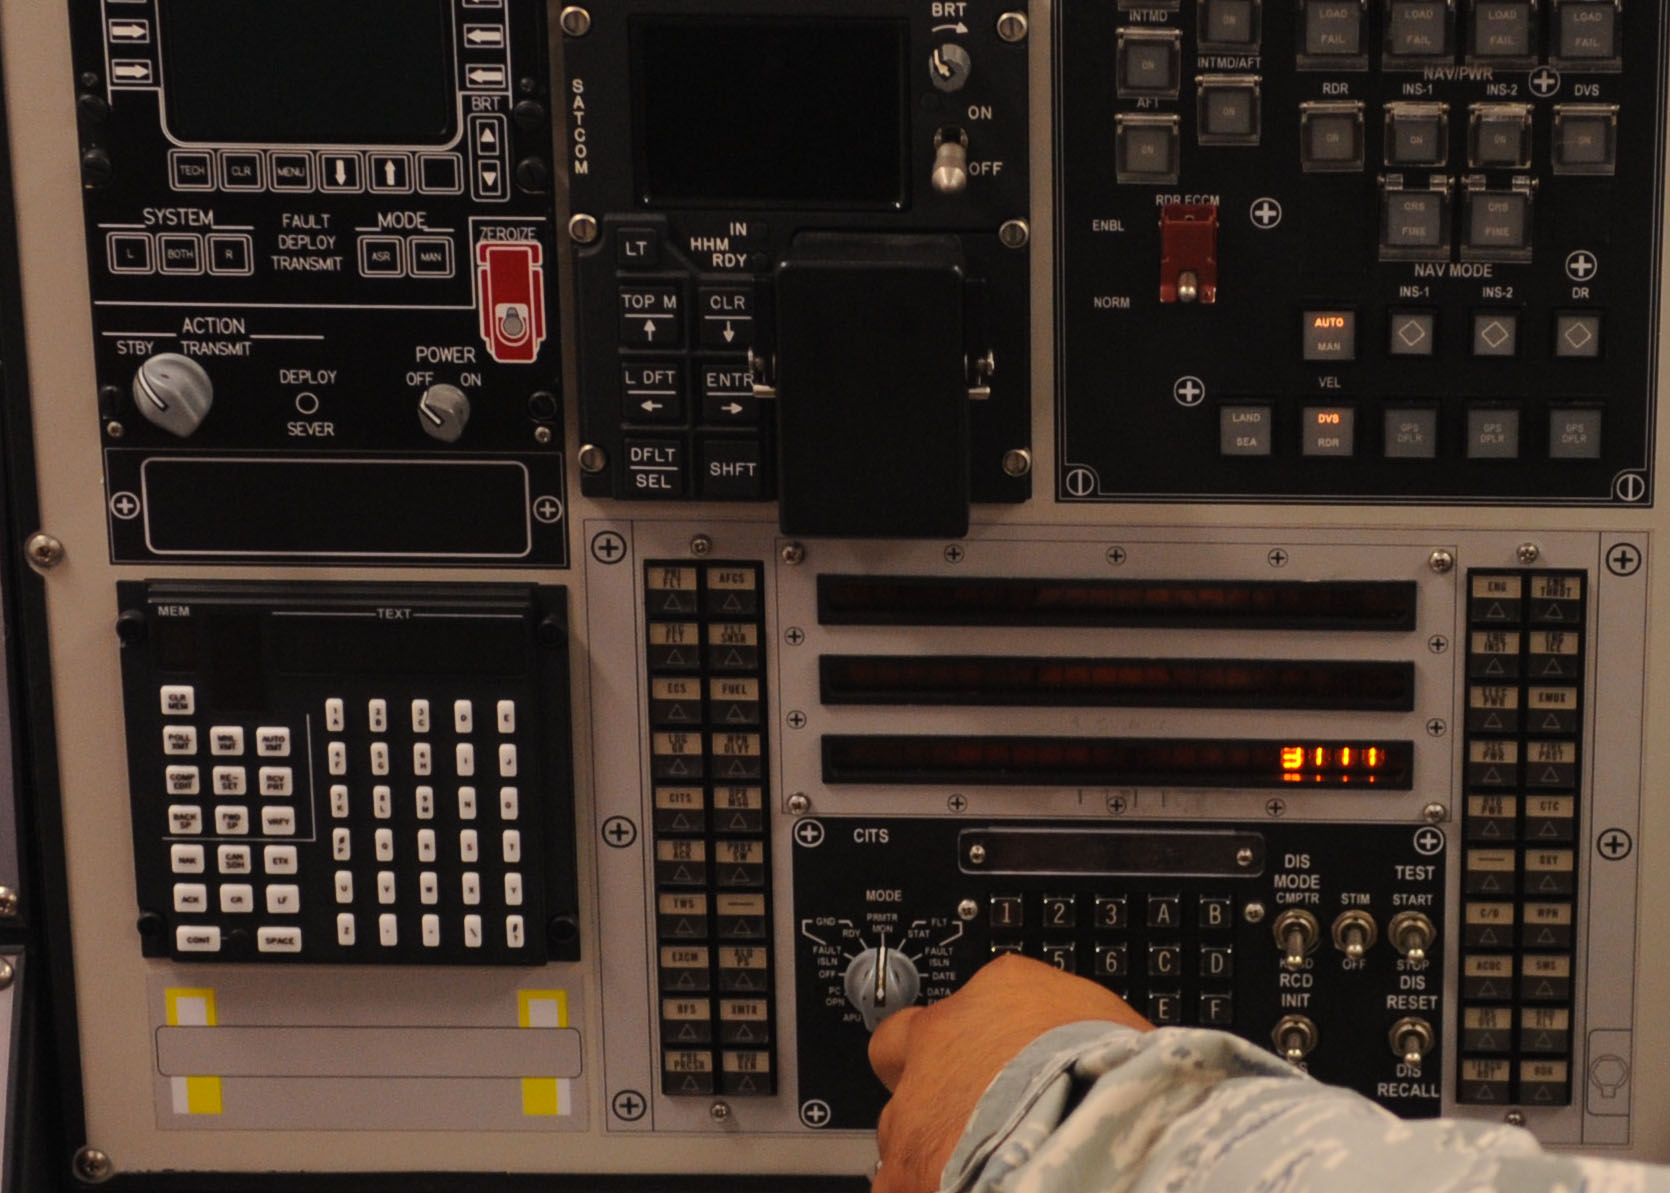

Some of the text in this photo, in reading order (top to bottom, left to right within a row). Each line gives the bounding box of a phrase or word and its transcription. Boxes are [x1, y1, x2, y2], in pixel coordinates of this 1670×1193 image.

[932, 3, 966, 17] BRT
[1129, 10, 1167, 23] INTMD
[1198, 57, 1262, 69] INTMD/AFT
[1424, 66, 1493, 82] NAV/PWR
[1323, 83, 1349, 95] RDR
[1403, 83, 1432, 96] INS-1
[1487, 84, 1518, 96] INS-2
[1575, 84, 1599, 97] DVS
[472, 97, 500, 111] BRT
[1137, 97, 1159, 109] AFT
[968, 107, 992, 120] ON
[572, 79, 588, 174] SATCOM
[180, 166, 205, 176] TECH
[231, 166, 251, 176] CLR
[277, 166, 304, 177] MENU
[969, 162, 1002, 176] OFF
[1156, 195, 1182, 207] RDR
[144, 209, 213, 226] SYSTEM
[283, 214, 330, 229] FAULT
[378, 212, 426, 229] MODE
[730, 223, 747, 237] IN
[1093, 220, 1124, 232] ENBL
[480, 227, 536, 242] ZEROIZE
[279, 235, 335, 250] DEPLOY
[625, 241, 647, 255] LT
[690, 238, 729, 251] HHM
[168, 249, 194, 260] BOTH
[421, 252, 441, 262] MAN
[712, 254, 747, 267] RDY
[272, 256, 341, 272] TRANSMIT
[1415, 264, 1493, 277] NAV MODE
[1400, 286, 1430, 297] INS-1
[1483, 287, 1513, 298] INS-2
[1572, 287, 1589, 299] DR
[623, 295, 677, 309] TOP M
[710, 296, 745, 310] CLR
[1094, 297, 1130, 308] NORM
[182, 318, 245, 334] ACTION
[1314, 317, 1344, 328] AUTO
[117, 341, 153, 355] STBY
[182, 341, 251, 356] TRANSMIT
[416, 347, 476, 363] POWER
[280, 370, 337, 385] DEPLOY
[406, 372, 433, 387] OFF
[460, 373, 481, 387] ON
[625, 371, 675, 385] L DFT
[707, 373, 755, 387] ENTR
[1318, 377, 1341, 388] VEL
[287, 423, 334, 437] SEVER
[631, 449, 675, 462] DFLT
[710, 463, 756, 477] SHFT
[636, 475, 671, 489] SEL
[720, 573, 744, 583] AFCS
[158, 606, 190, 617] MEM
[376, 608, 412, 620] TEXT
[722, 684, 746, 694] FUEL
[262, 735, 285, 743] AUTO
[853, 829, 889, 843] CITS
[1285, 854, 1310, 868] DIS
[1396, 866, 1434, 880] TEST
[1274, 874, 1320, 889] MODE
[866, 891, 902, 901] MODE
[1276, 892, 1319, 904] CMPTR
[1341, 893, 1370, 905] STIM
[1393, 894, 1433, 906] START
[1002, 904, 1010, 923] 1
[1054, 904, 1064, 924] 2
[1106, 905, 1116, 924] 3
[1158, 904, 1170, 923] A
[1210, 906, 1221, 924] B
[908, 929, 930, 938] STAT
[265, 937, 294, 945] SPACE
[1054, 952, 1064, 970] 5
[1106, 952, 1116, 971] 6
[1159, 953, 1171, 971] C
[1211, 955, 1222, 973] D
[1343, 958, 1366, 970] OFF
[1280, 973, 1313, 988] RCD
[1401, 976, 1426, 990] DIS
[1281, 994, 1310, 1007] INIT
[1386, 995, 1438, 1009] RESET
[1159, 1000, 1169, 1018] E
[1211, 1002, 1220, 1019] F
[1396, 1064, 1421, 1078] DIS
[1378, 1083, 1440, 1097] RECALL
